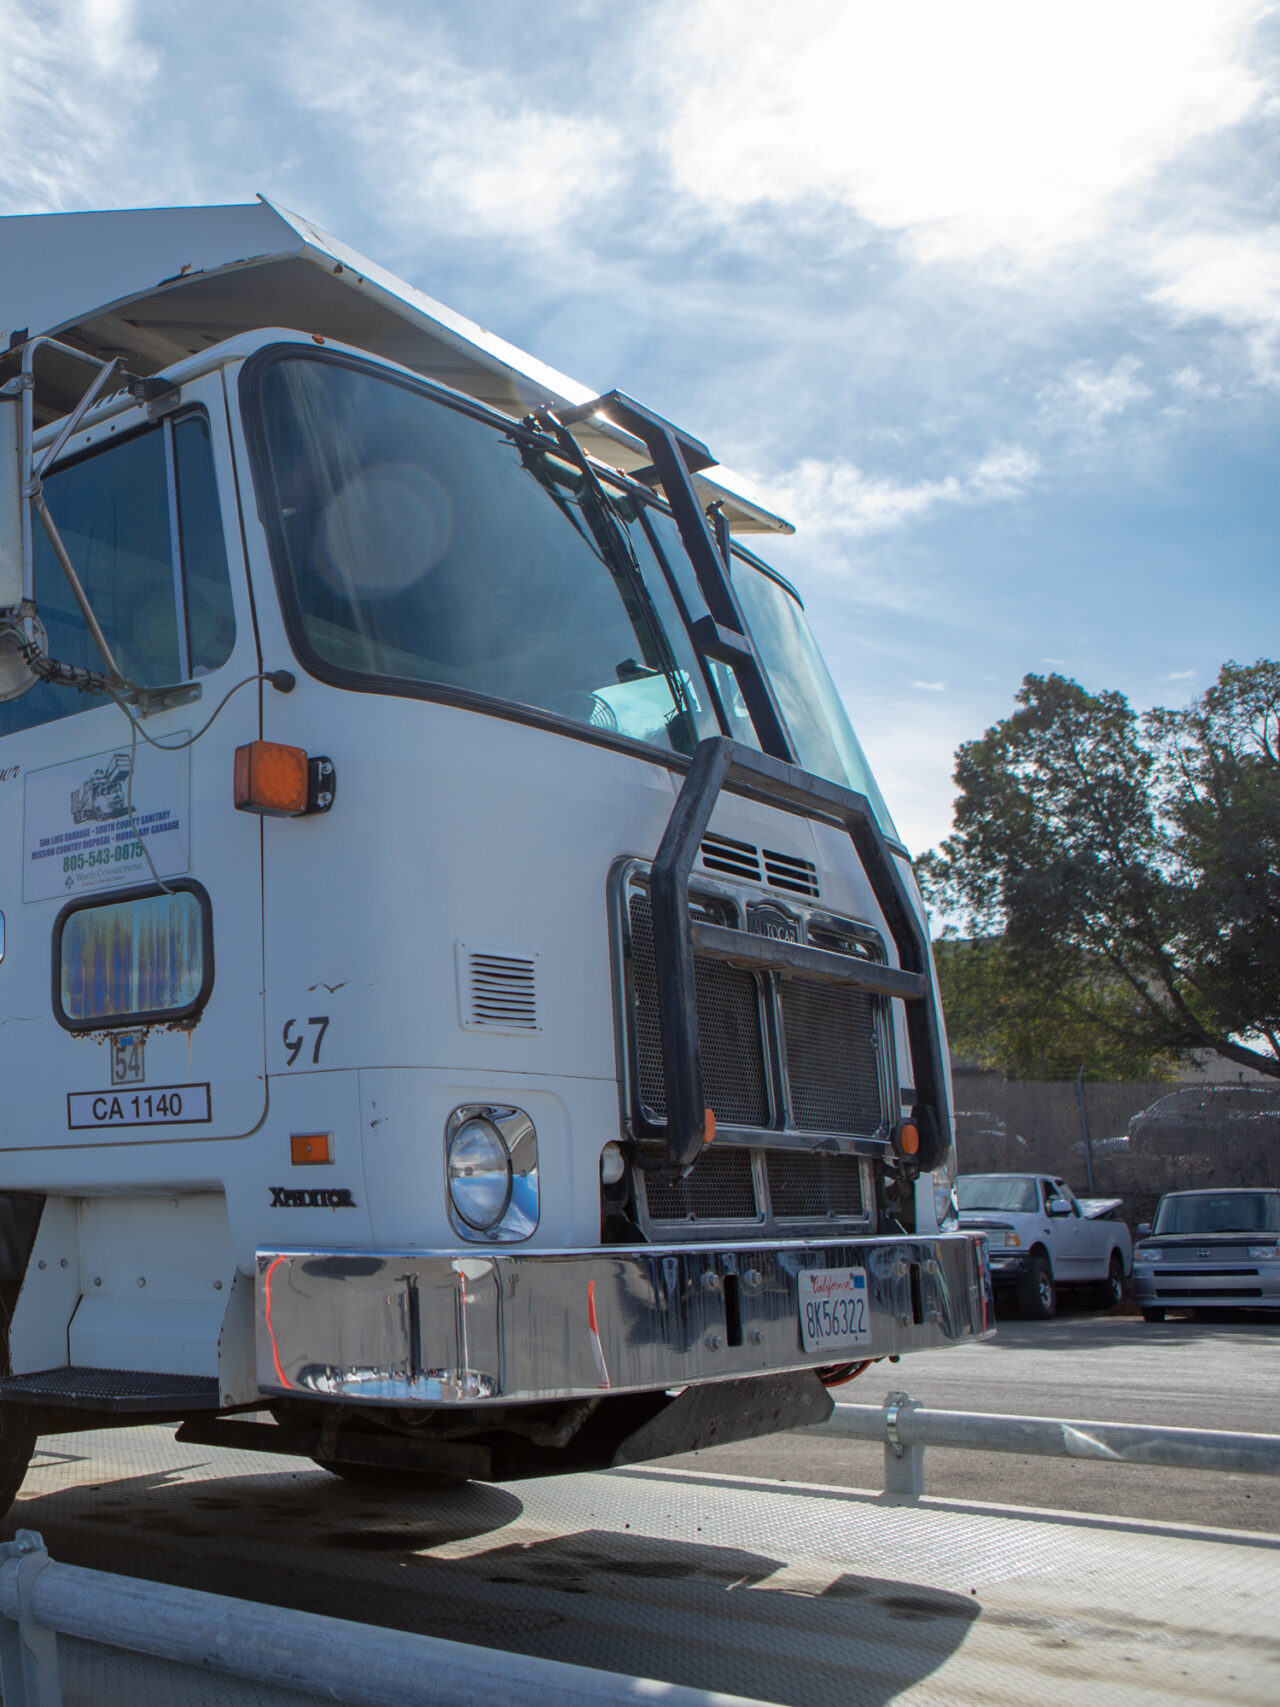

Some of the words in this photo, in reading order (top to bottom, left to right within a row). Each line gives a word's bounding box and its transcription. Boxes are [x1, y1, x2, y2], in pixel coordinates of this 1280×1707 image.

[95, 822, 115, 835] SOUTH
[141, 810, 171, 825] SANITARY
[31, 847, 55, 860] MISSION
[56, 842, 82, 857] COUNTRY
[83, 835, 111, 849] DISPOSAL
[151, 819, 180, 835] GARBAGE
[63, 841, 144, 873] 805-543-0875
[282, 1016, 330, 1067] 97
[115, 1046, 140, 1080] 54
[92, 1097, 124, 1120] CA
[131, 1092, 182, 1118] 1140
[812, 1274, 855, 1299] California
[806, 1298, 867, 1339] 8K56322
